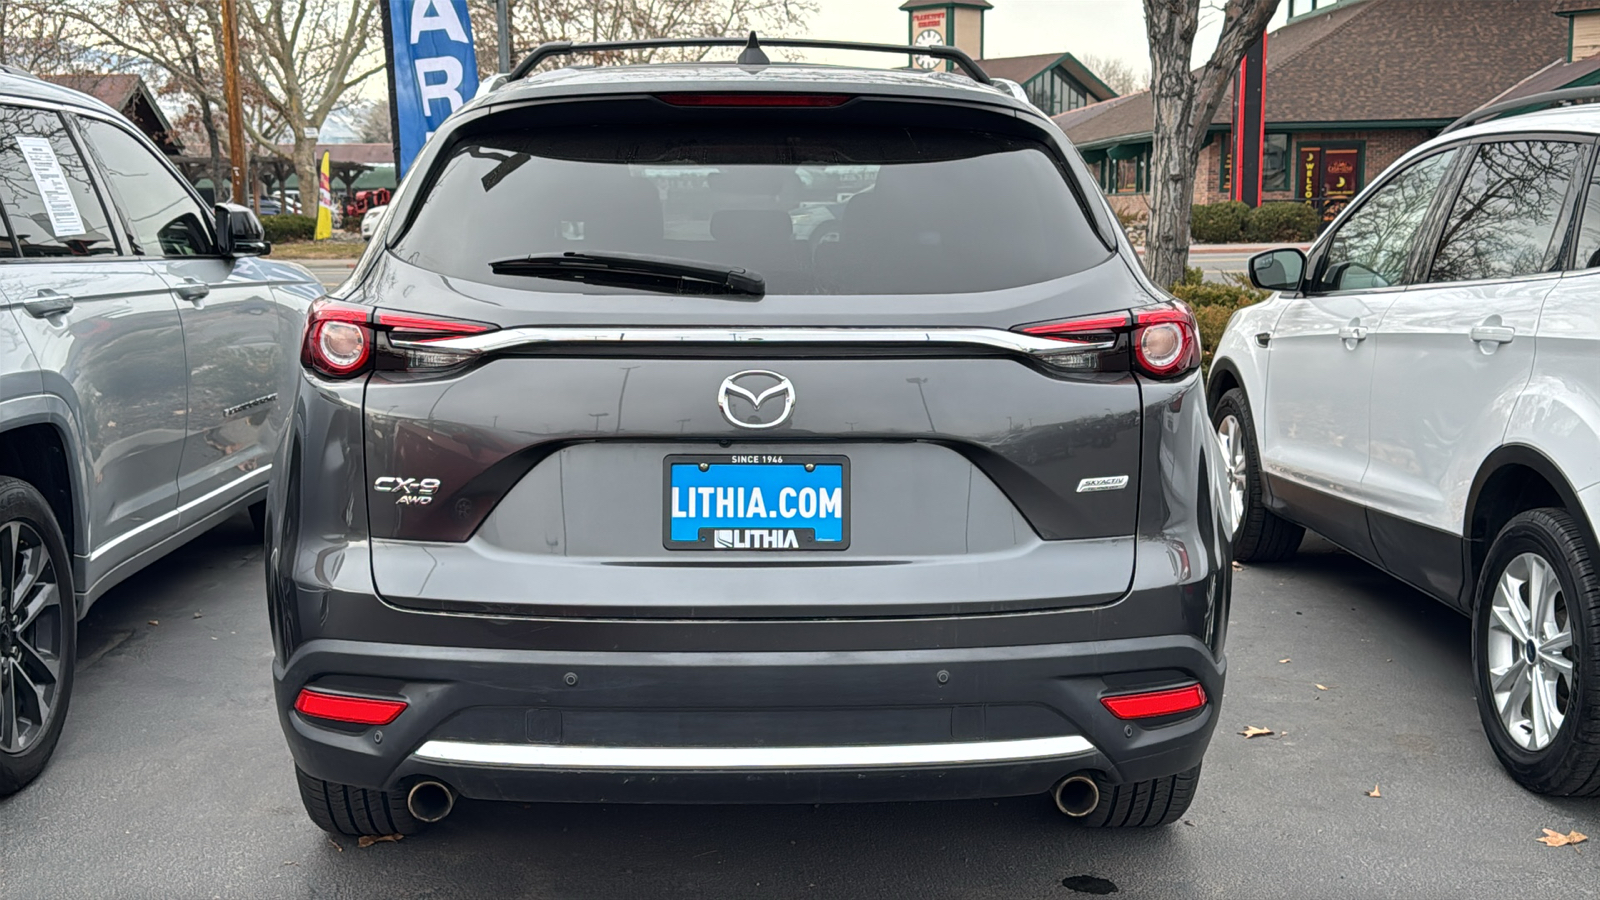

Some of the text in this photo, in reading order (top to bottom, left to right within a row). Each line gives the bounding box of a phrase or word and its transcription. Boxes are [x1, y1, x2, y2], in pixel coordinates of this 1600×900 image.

[410, 0, 470, 143] AR
[731, 455, 783, 463] SINCE 1946
[374, 476, 441, 495] CX-9
[1085, 478, 1124, 486] SKYACTIV
[395, 495, 432, 505] AWD
[672, 487, 842, 518] LITHIA.COM
[733, 529, 799, 548] LITHIA
